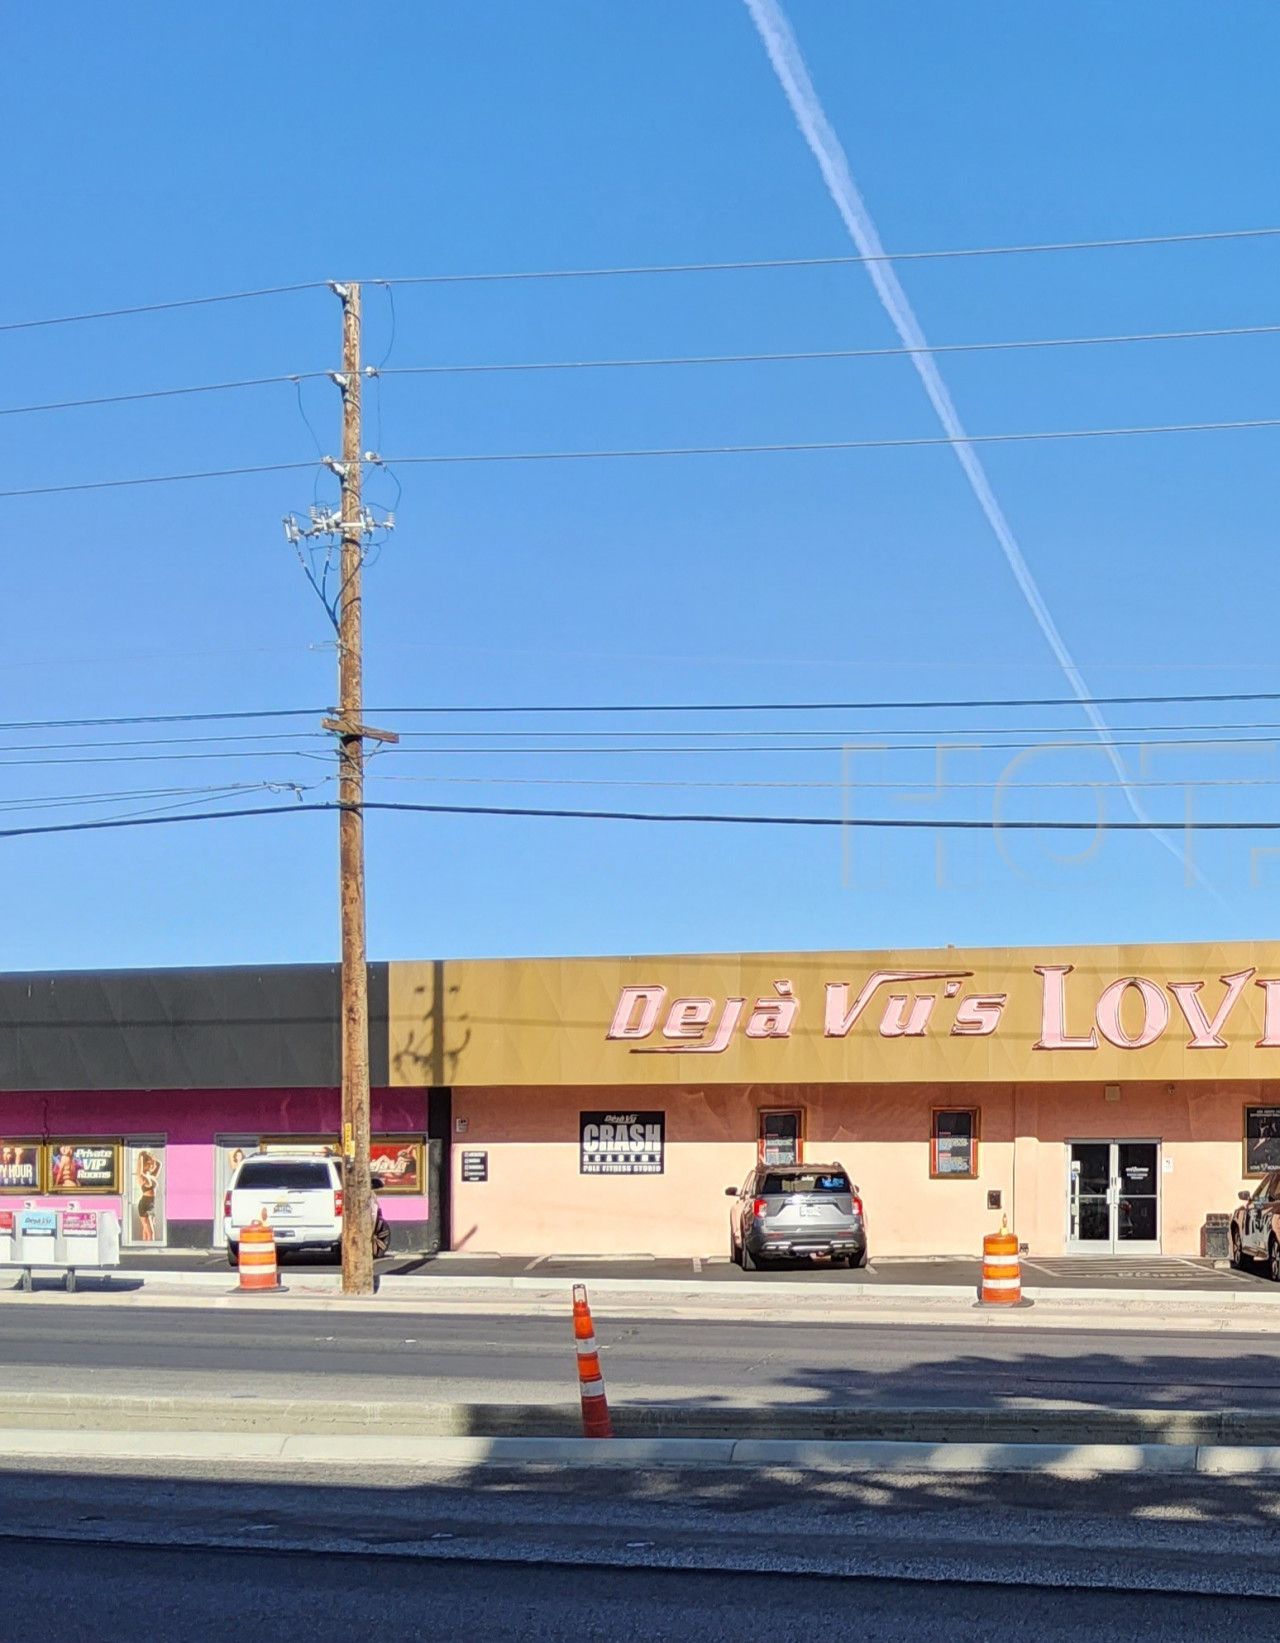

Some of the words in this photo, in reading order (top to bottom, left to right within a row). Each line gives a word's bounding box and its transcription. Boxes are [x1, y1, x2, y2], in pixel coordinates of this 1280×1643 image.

[824, 970, 1008, 1038] Vu's
[583, 1124, 661, 1152] CRASH
[76, 1148, 112, 1158] Private
[83, 1159, 106, 1170] VIP
[9, 1164, 33, 1178] HOUR
[77, 1171, 111, 1179] Rooms
